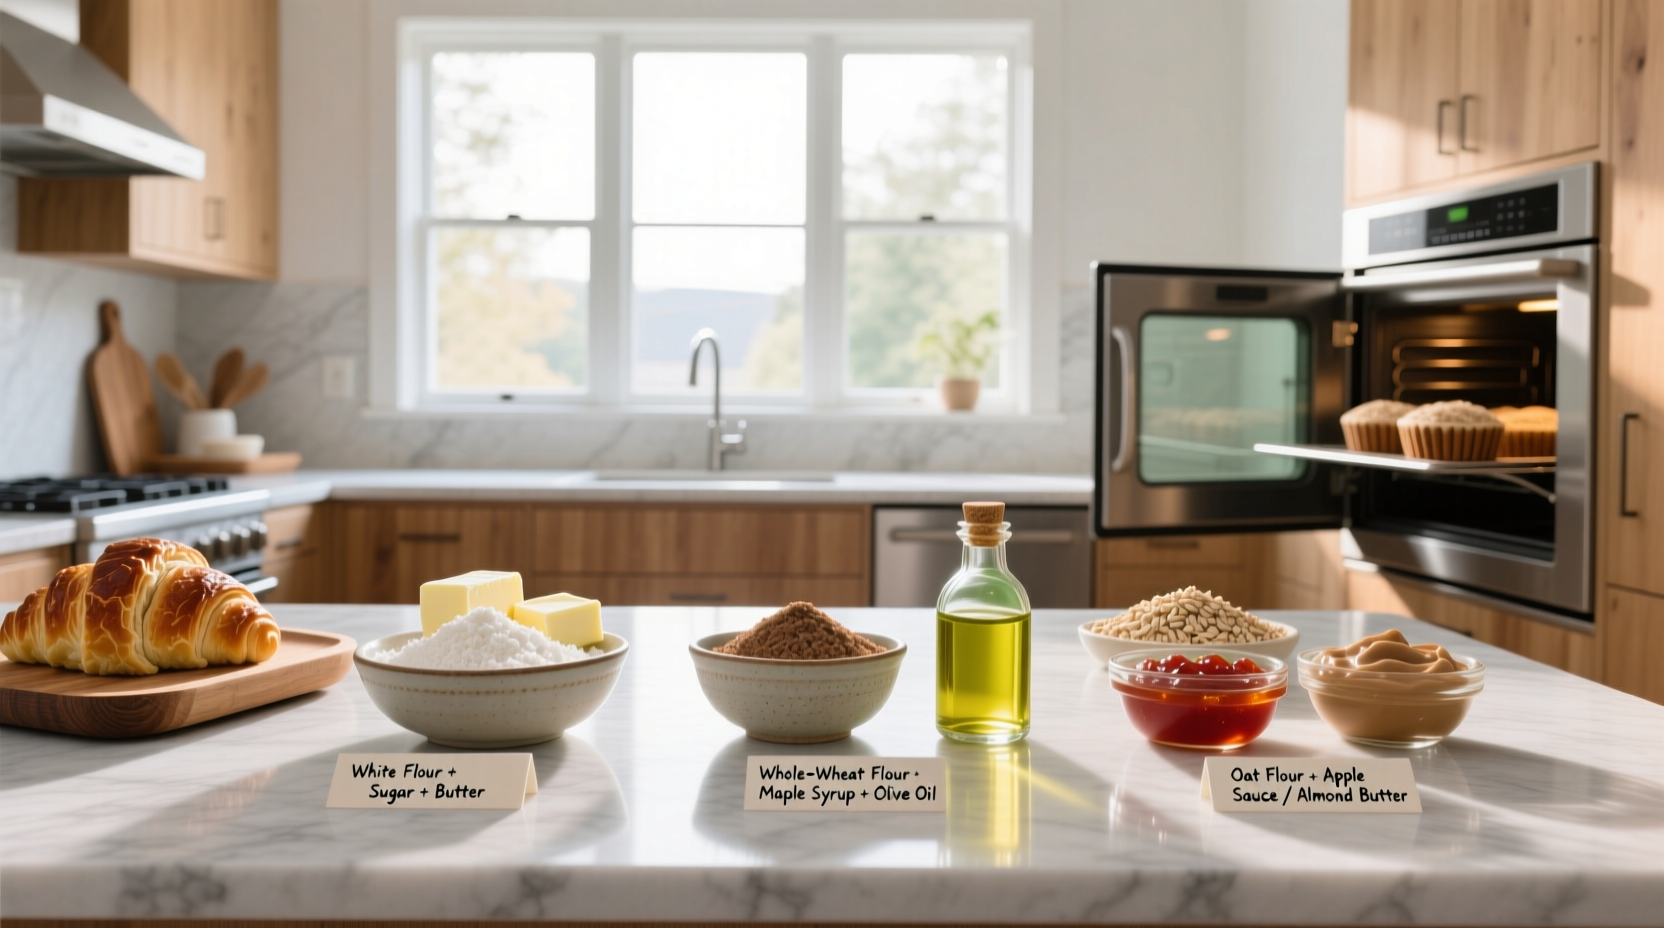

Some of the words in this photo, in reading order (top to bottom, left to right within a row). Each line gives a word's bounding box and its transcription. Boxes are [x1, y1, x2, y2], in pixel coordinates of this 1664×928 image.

[353, 763, 396, 779] White
[403, 763, 443, 779] Flour
[448, 768, 457, 778] +
[759, 765, 866, 781] Whole-Wheat
[871, 765, 911, 781] Flour
[1231, 766, 1261, 782] Oat
[1266, 766, 1305, 782] Flour
[1308, 772, 1318, 782] +
[1323, 766, 1366, 788] Apple
[369, 784, 416, 805] Sugar
[420, 788, 429, 798] +
[435, 783, 486, 798] Butter
[759, 785, 806, 806] Maple
[811, 785, 856, 807] Syrup
[860, 789, 869, 799] +
[874, 785, 911, 801] Olive
[915, 785, 937, 801] Oil
[1232, 787, 1279, 803] Sauce
[1282, 786, 1293, 807] /
[1297, 787, 1354, 803] Almond
[1358, 787, 1408, 803] Butter
